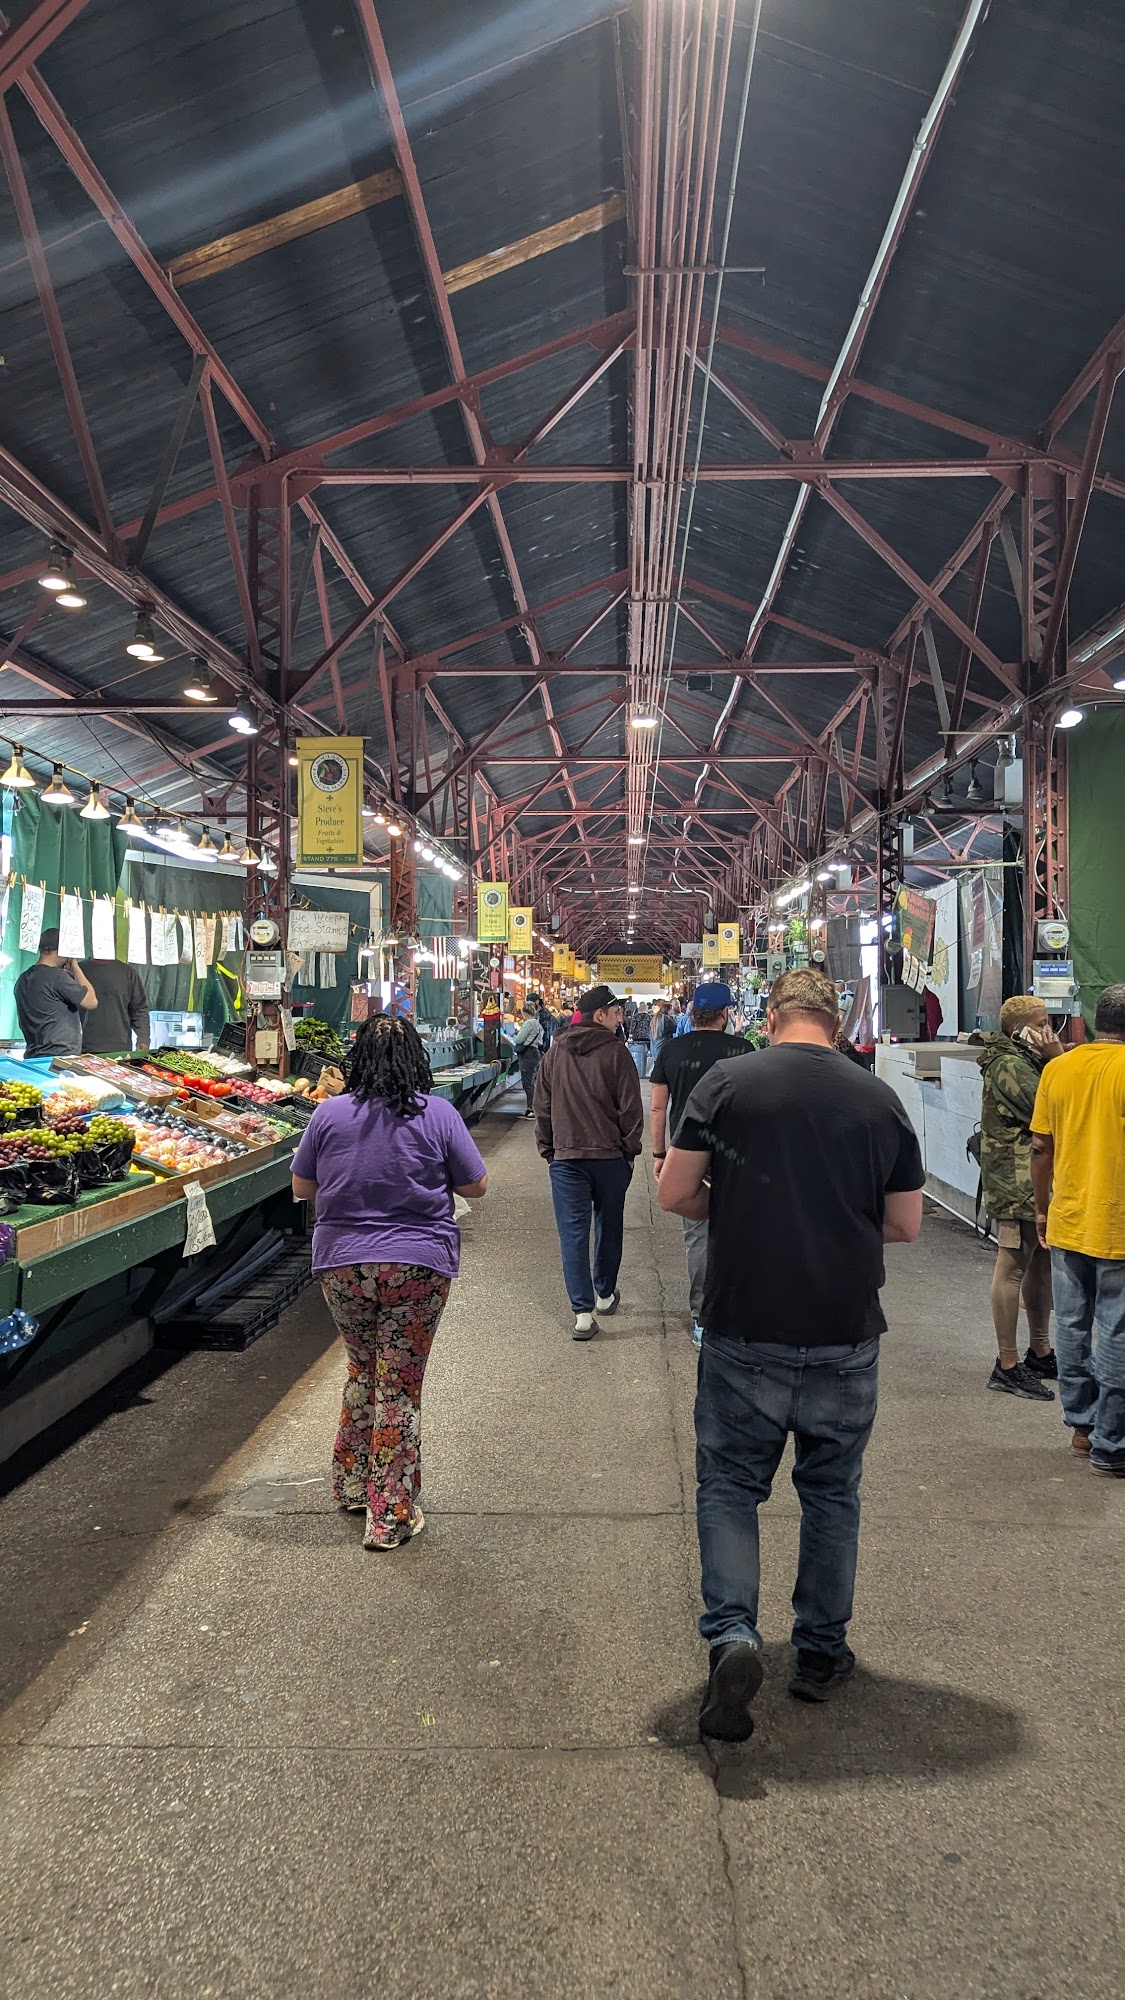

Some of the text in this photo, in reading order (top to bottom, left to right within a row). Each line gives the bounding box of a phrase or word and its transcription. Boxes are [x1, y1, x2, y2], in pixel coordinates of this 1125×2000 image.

[317, 803, 343, 814] Steve's
[315, 816, 345, 826] Produce
[315, 837, 345, 845] Vegetables
[291, 910, 346, 925] We Accept
